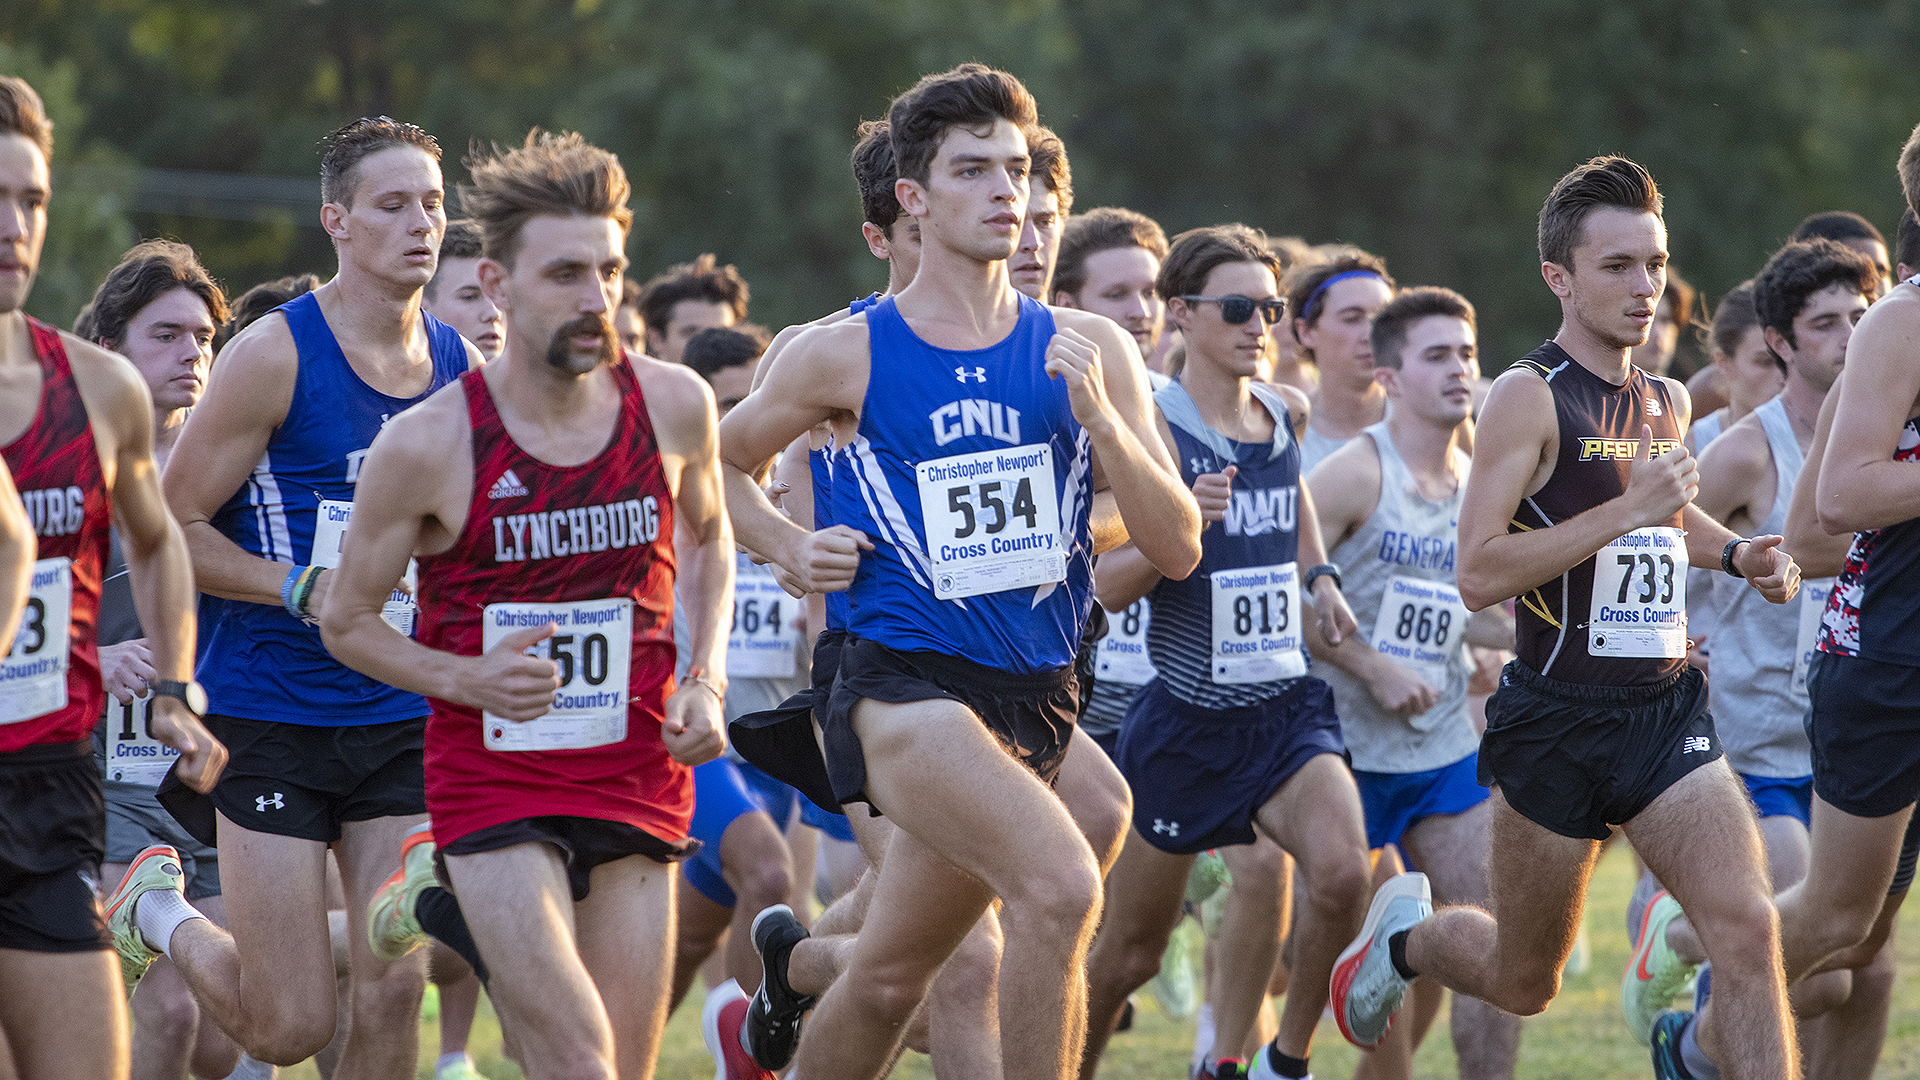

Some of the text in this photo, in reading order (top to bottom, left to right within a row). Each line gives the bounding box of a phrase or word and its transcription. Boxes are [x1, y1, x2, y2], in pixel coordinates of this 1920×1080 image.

[929, 398, 1021, 446] CNU
[928, 450, 1044, 482] Christopher Newport
[487, 486, 529, 500] adidas
[947, 477, 1037, 539] 554
[492, 496, 660, 562] LYNCHBURG
[940, 533, 1053, 561] Cross Country
[1220, 575, 1268, 590] Christopher
[1616, 553, 1675, 605] 733
[496, 604, 622, 627] Christopher Newport
[1233, 589, 1289, 637] 813
[1395, 603, 1451, 646] 868
[1600, 606, 1681, 626] Cross Country
[1106, 639, 1142, 654] Cross
[1221, 636, 1296, 654] Cross Country
[530, 633, 608, 686] 50
[552, 691, 619, 709] Country
[116, 743, 157, 757] Cross
